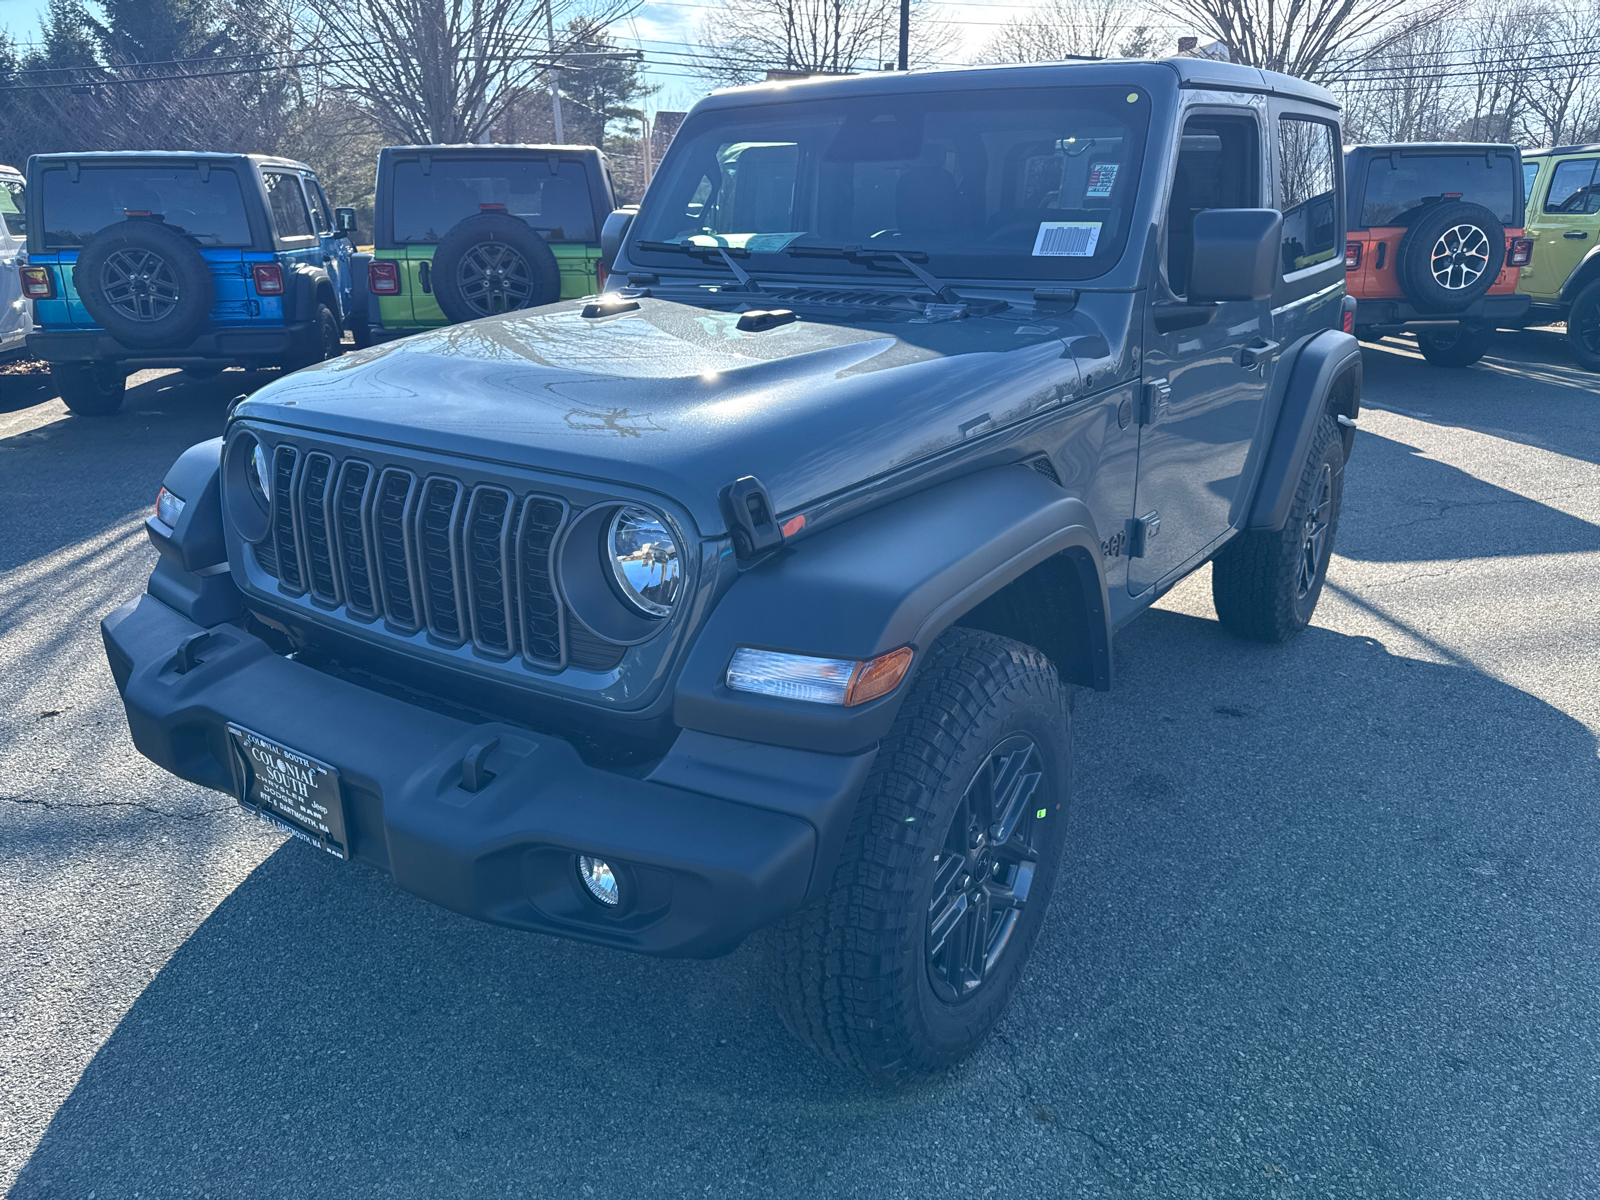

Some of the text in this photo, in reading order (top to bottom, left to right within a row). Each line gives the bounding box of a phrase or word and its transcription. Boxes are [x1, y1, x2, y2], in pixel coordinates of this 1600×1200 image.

[1099, 530, 1128, 558] eep
[251, 747, 318, 788] COLONIAL
[284, 750, 310, 767] SOUTH
[255, 773, 328, 815] CHRYSLER Jeep
[265, 765, 309, 798] SOUTH
[260, 791, 272, 804] RTE.
[279, 802, 318, 829] DARTMOUTH,
[319, 822, 330, 833] MA
[263, 785, 322, 820] DODGE RAM
[312, 838, 322, 849] MA
